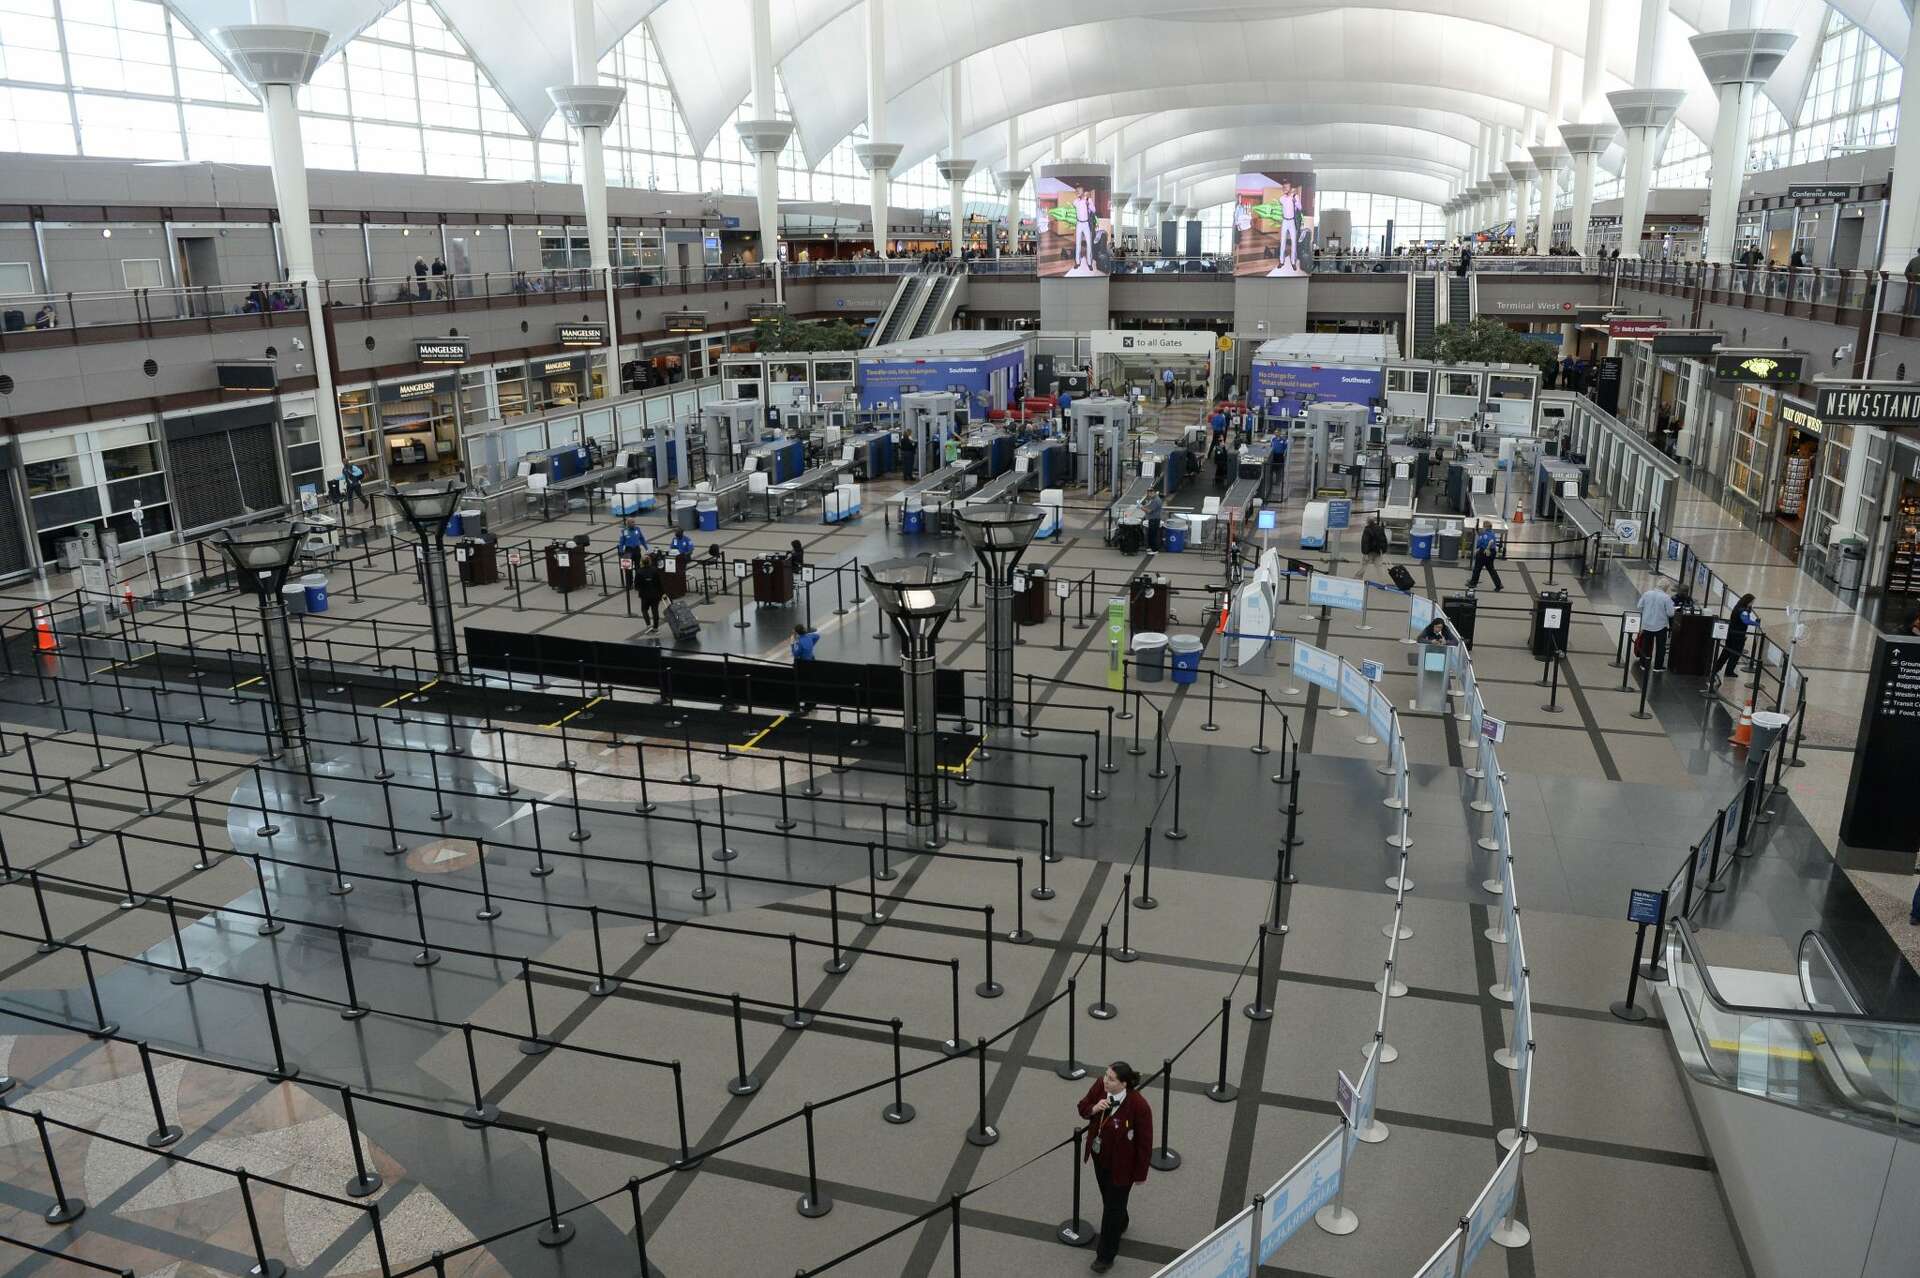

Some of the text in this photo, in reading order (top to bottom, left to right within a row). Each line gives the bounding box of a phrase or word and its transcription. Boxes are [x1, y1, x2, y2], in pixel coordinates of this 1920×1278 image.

[1496, 301, 1534, 310] Terminal
[561, 329, 601, 337] MANGELSEN
[1137, 338, 1183, 347] to all Gates
[420, 345, 464, 354] MANGELSEN
[400, 382, 434, 394] MANGELSEN
[1826, 392, 1920, 419] NEWSSTAND
[1783, 406, 1823, 433] WAY OUT WEST
